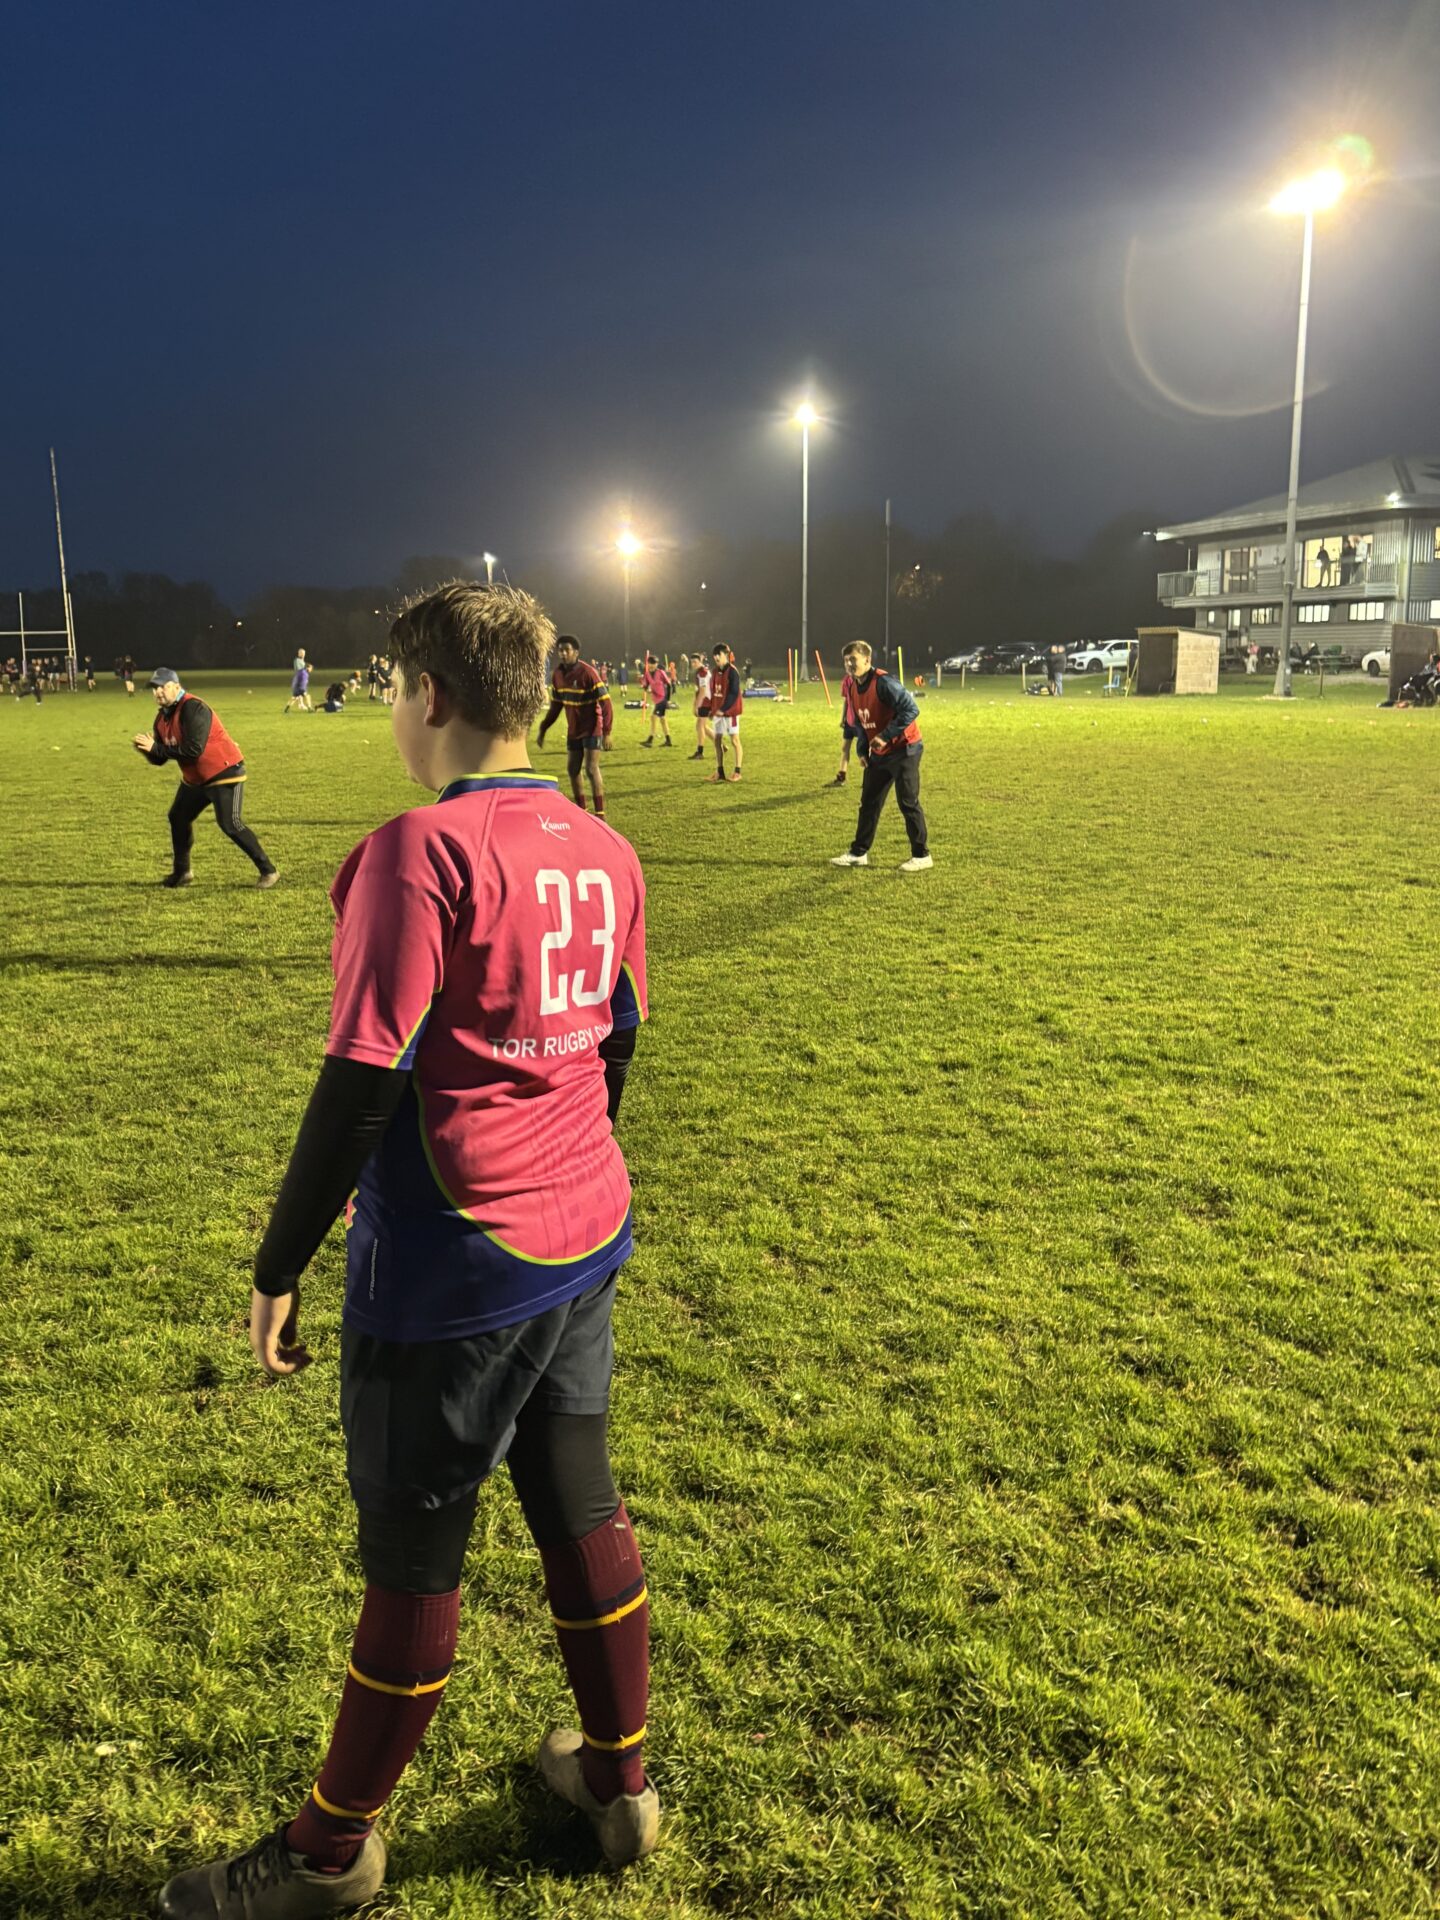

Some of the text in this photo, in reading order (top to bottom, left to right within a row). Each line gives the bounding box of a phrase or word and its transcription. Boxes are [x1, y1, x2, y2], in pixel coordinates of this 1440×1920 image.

[534, 868, 616, 1016] 23
[487, 1037, 537, 1059] TOR
[543, 1027, 595, 1057] RUGBY
